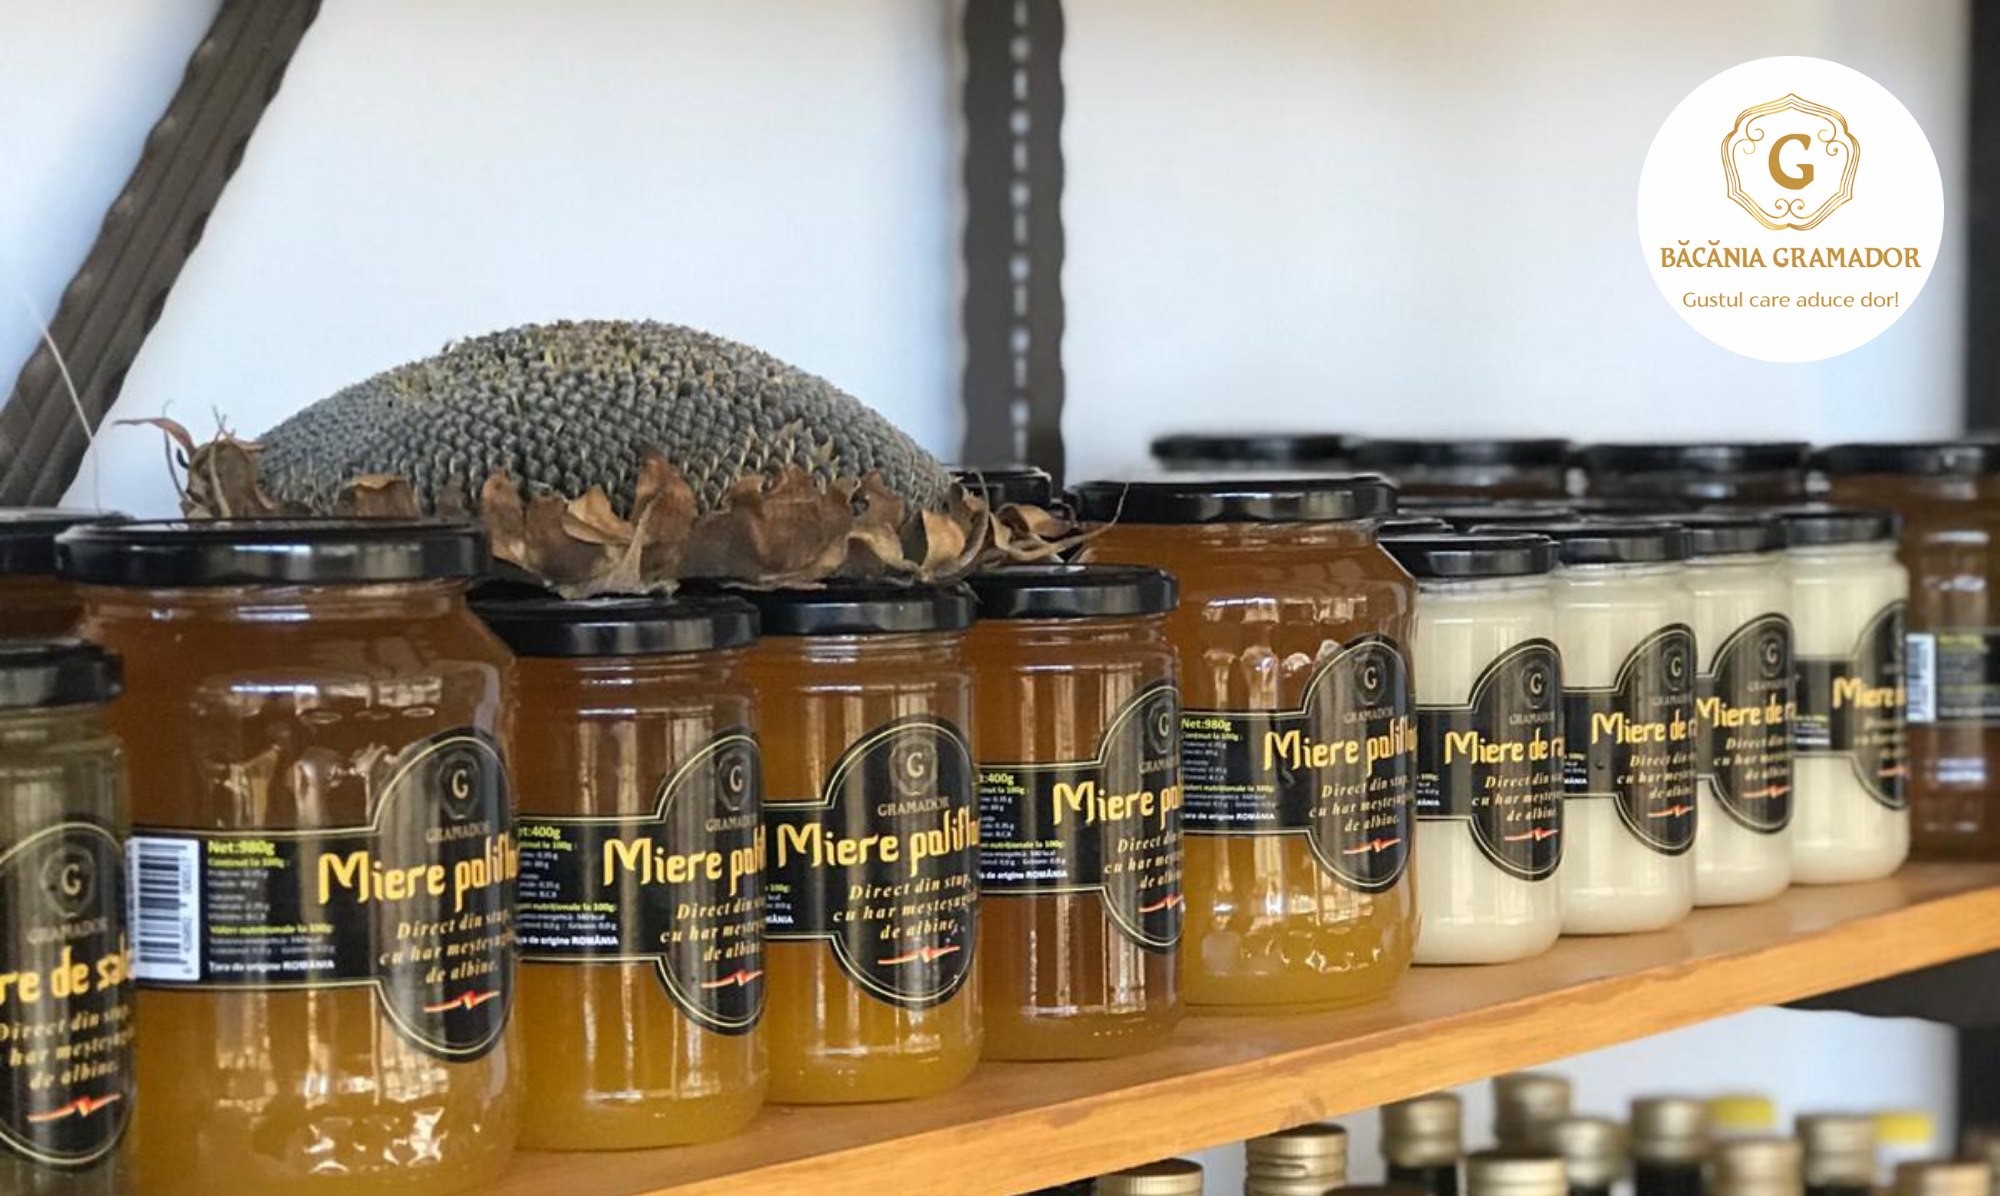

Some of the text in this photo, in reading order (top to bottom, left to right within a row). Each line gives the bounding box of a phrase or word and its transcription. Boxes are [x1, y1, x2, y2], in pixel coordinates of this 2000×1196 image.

[1364, 666, 1378, 690] G
[1591, 712, 1667, 745] Miere
[1670, 708, 1687, 741] de
[1264, 730, 1359, 771] Miere
[1444, 731, 1525, 765] Miere
[1529, 727, 1549, 761] de
[907, 753, 923, 776] G
[452, 769, 468, 799] G
[729, 766, 743, 792] G
[1321, 783, 1366, 798] Direct
[877, 796, 950, 817] GRAMADOR
[1053, 782, 1154, 826] Miere
[1308, 807, 1328, 819] cu
[1332, 802, 1356, 816] har
[777, 823, 898, 868] Miere
[604, 838, 722, 886] Miere
[61, 863, 81, 895] G
[319, 851, 445, 905] Miere
[848, 882, 911, 901] Direct
[914, 878, 940, 894] din
[677, 902, 729, 919] Direct
[833, 911, 856, 922] cu
[863, 905, 897, 920] har
[397, 918, 455, 940] Direct
[459, 913, 482, 931] din
[660, 932, 682, 943] cu
[689, 925, 718, 941] har
[880, 924, 900, 940] de
[379, 951, 403, 966] cu
[411, 944, 442, 962] har
[703, 945, 722, 961] de
[51, 945, 89, 998] de
[425, 966, 446, 985] de
[71, 1010, 99, 1032] din
